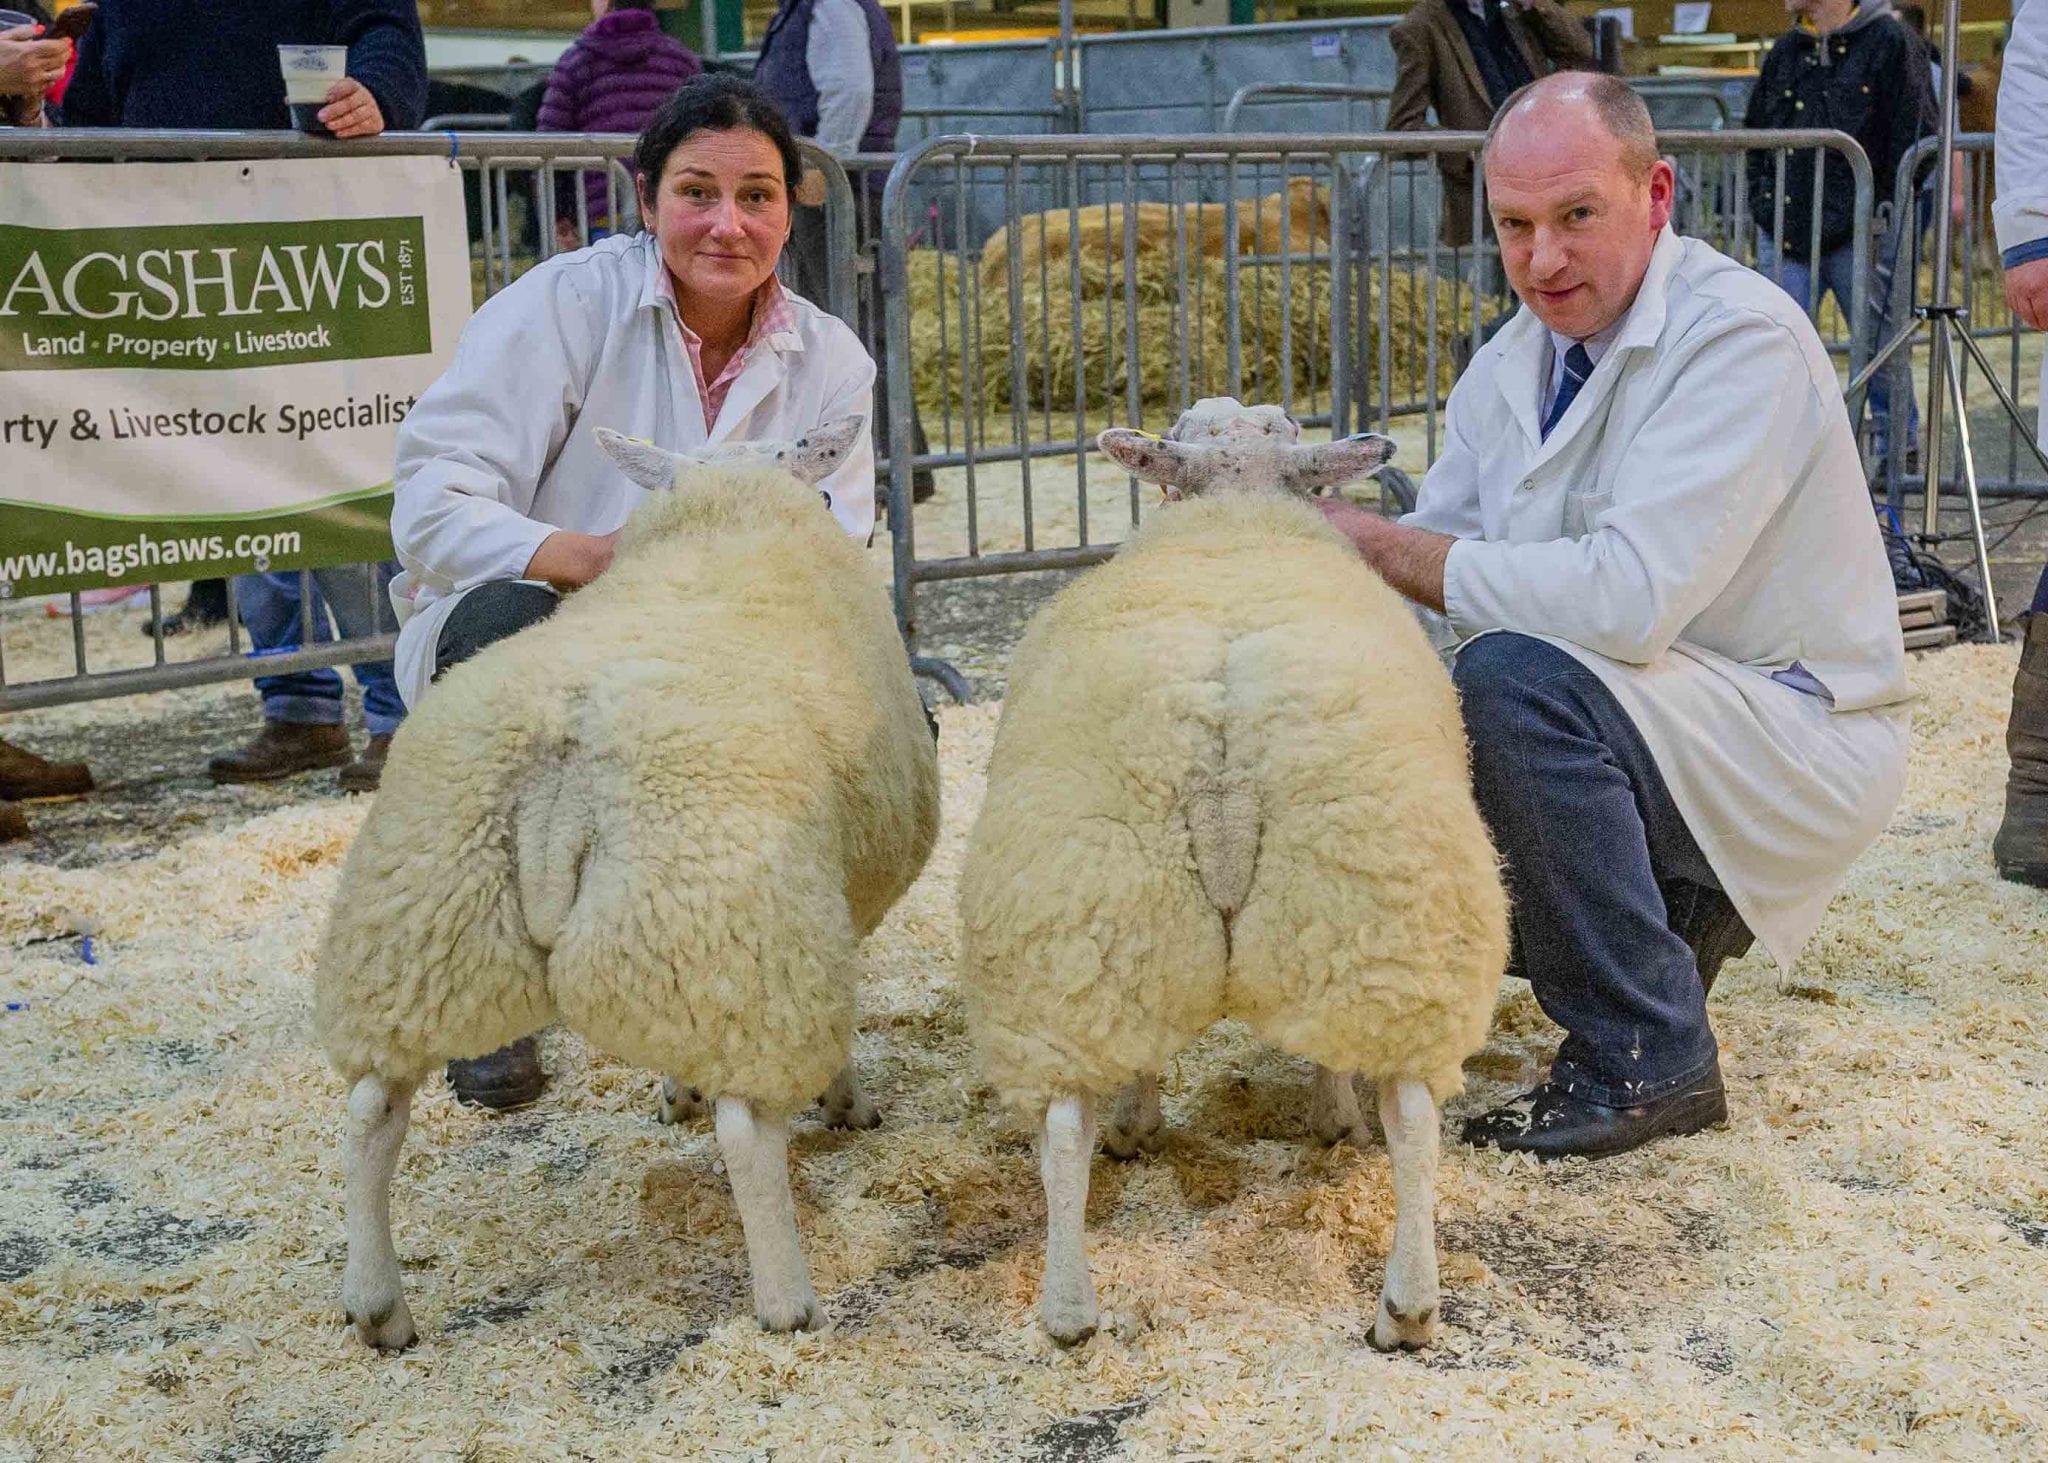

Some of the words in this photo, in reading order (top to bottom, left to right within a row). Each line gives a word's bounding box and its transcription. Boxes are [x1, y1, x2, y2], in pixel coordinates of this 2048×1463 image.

[398, 239, 413, 269] 1871
[0, 239, 390, 320] AGSHAWS
[399, 271, 415, 306] EST
[22, 331, 86, 356] Land
[107, 333, 218, 362] Property
[235, 324, 331, 354] Livestock
[3, 414, 59, 449] rty
[70, 408, 100, 441] &
[109, 404, 267, 439] Livestock
